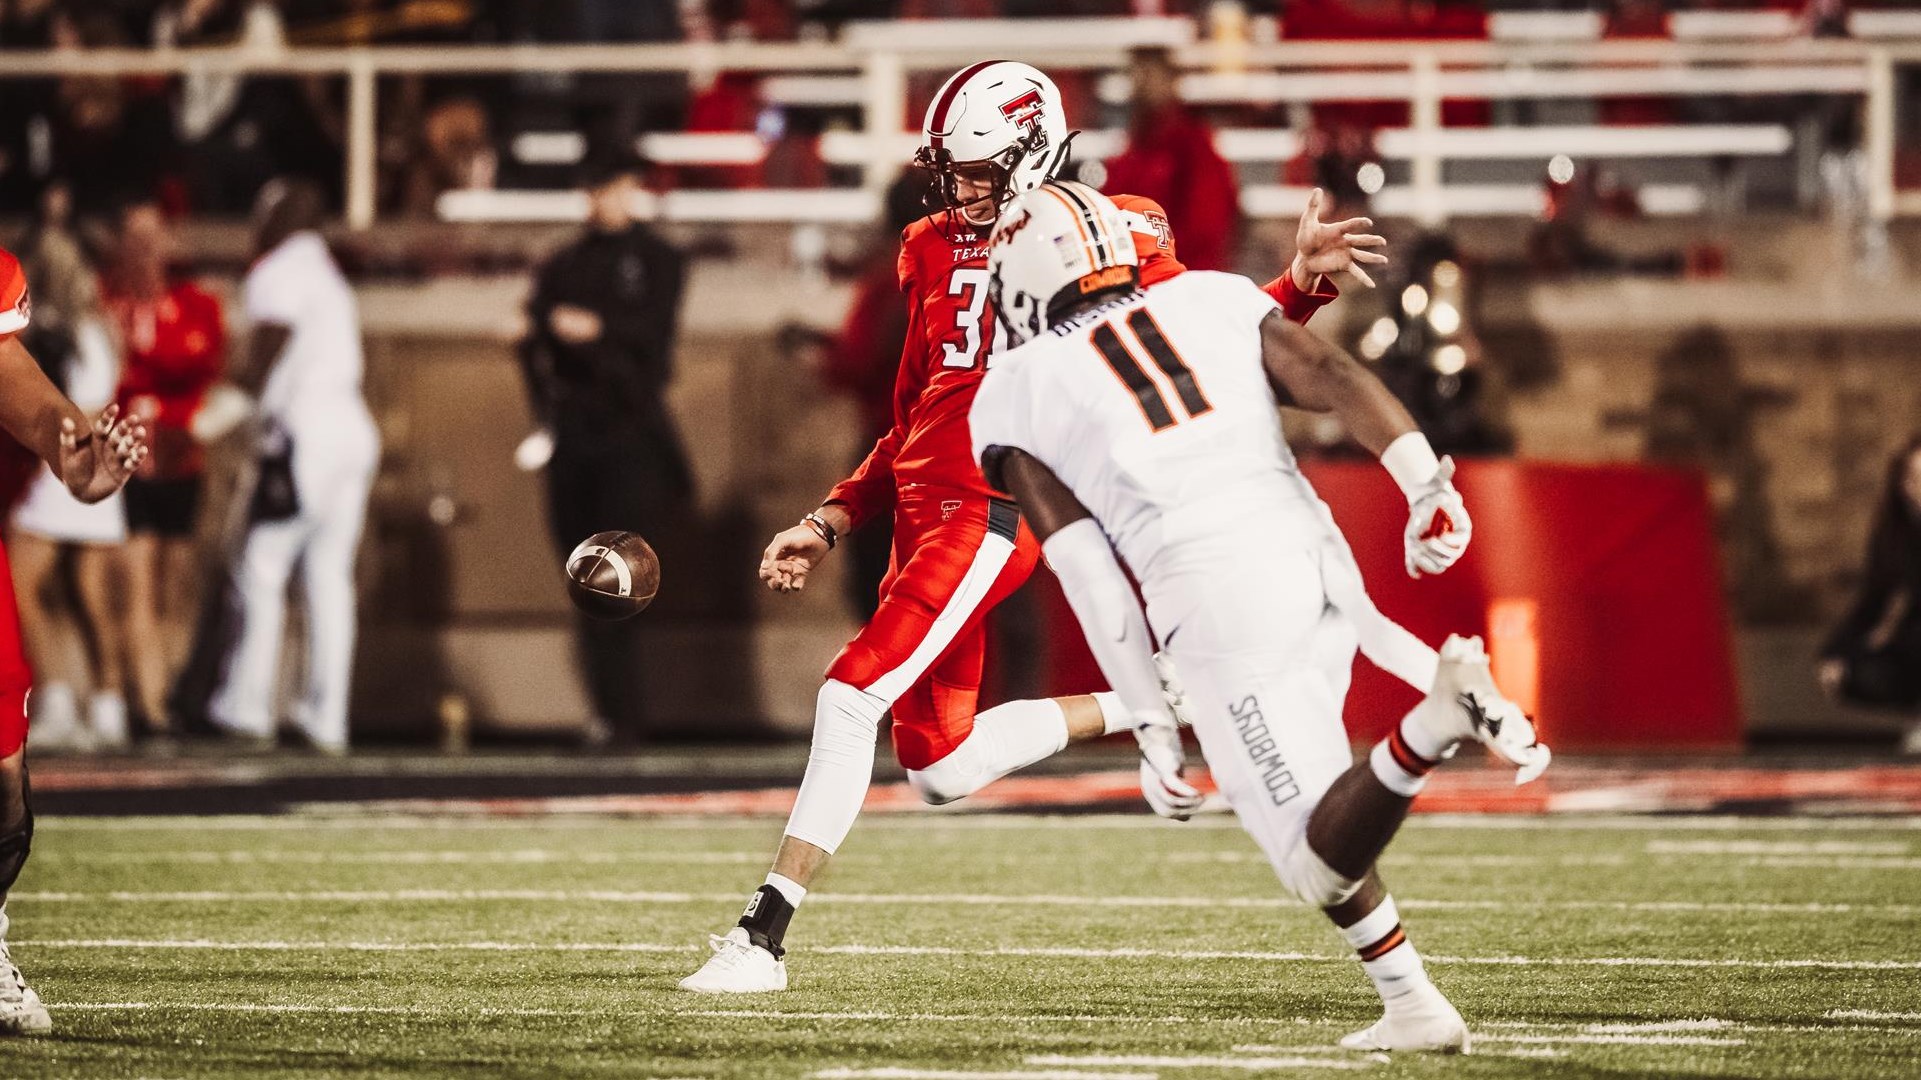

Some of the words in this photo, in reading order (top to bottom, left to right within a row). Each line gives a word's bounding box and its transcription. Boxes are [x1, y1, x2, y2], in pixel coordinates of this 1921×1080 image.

[952, 246, 990, 261] TEXA
[1089, 306, 1214, 432] 11
[1229, 695, 1300, 806] COWBOYS
